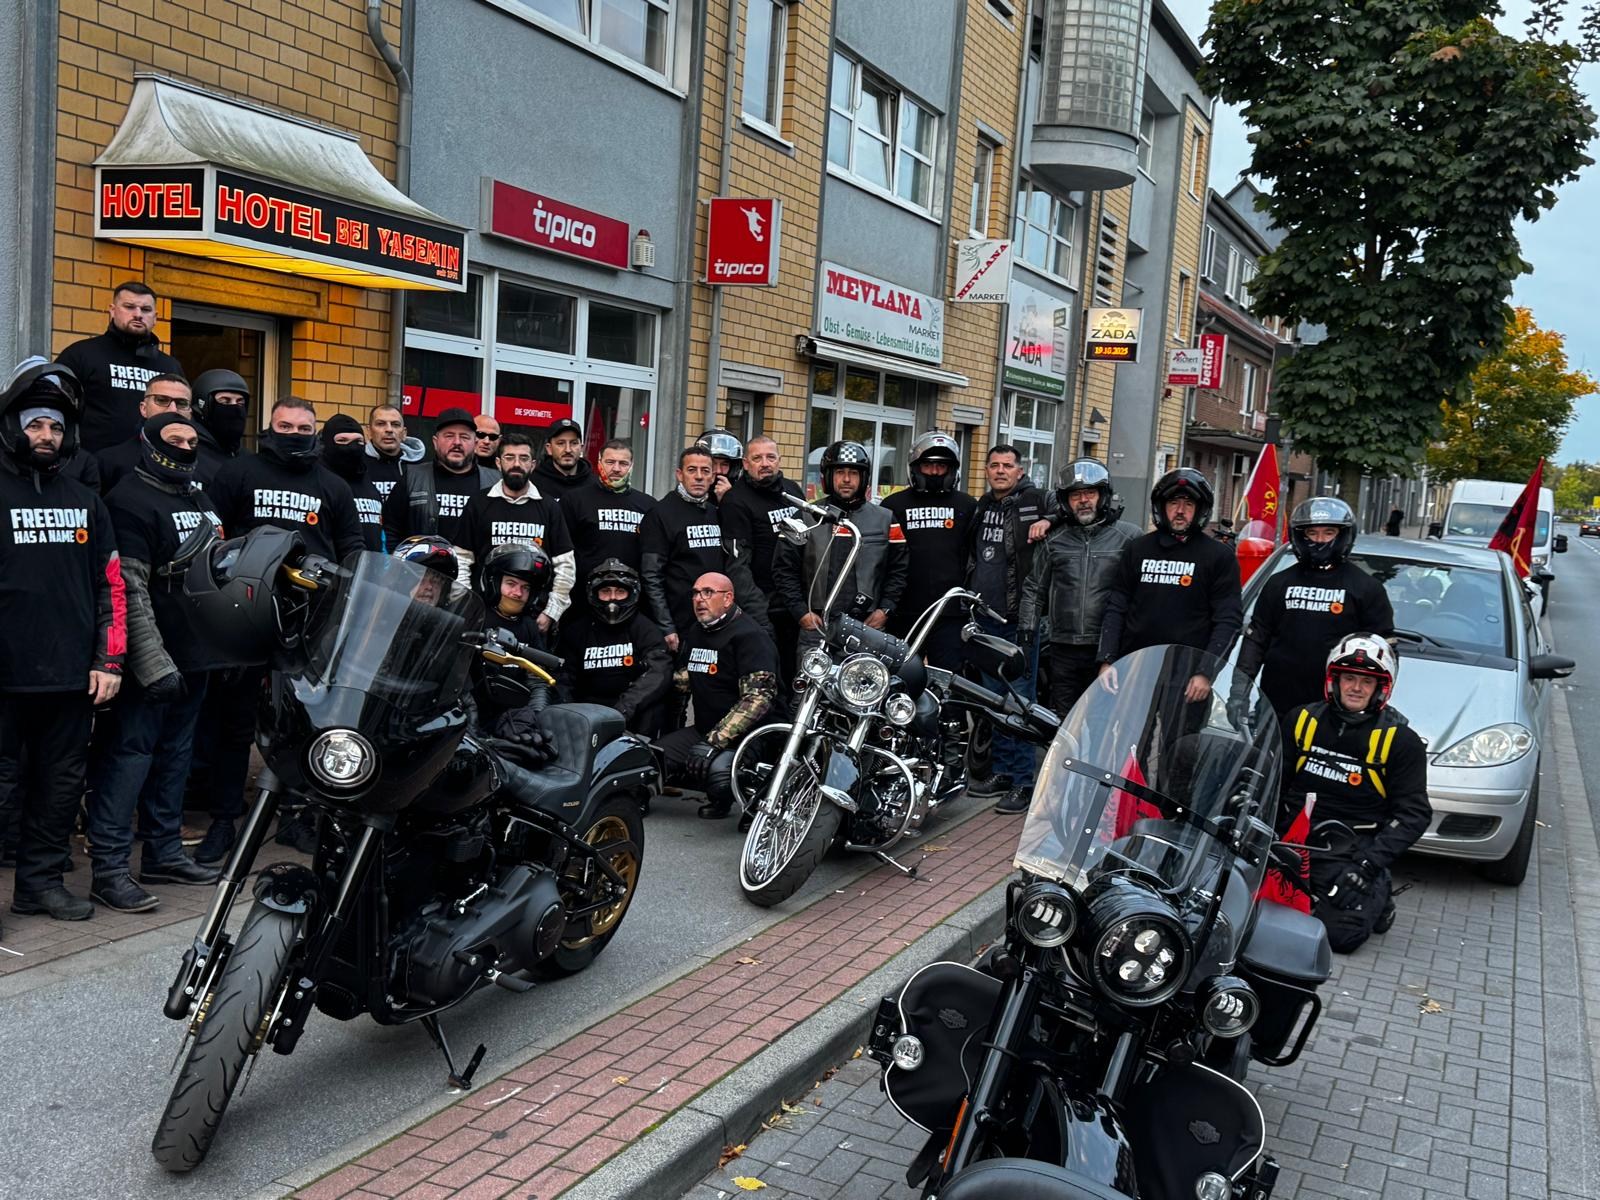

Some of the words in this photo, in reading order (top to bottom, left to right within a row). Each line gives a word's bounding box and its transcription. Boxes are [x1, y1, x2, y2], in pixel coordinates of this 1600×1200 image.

[102, 183, 201, 218] HOTEL
[217, 184, 332, 245] HOTEL
[335, 216, 369, 250] BEI
[377, 227, 460, 271] YASEMIN
[533, 199, 597, 248] tipico
[714, 258, 765, 278] tipico
[956, 244, 1009, 300] MEVLANA
[826, 269, 923, 321] MEVLANA
[969, 293, 1005, 301] MARKET
[823, 316, 840, 335] Obst
[846, 323, 871, 342] Gemüse
[876, 331, 914, 353] Lebensmittel
[915, 340, 920, 354] &
[921, 342, 940, 358] Fleisch
[908, 324, 940, 341] MARKET
[1091, 328, 1137, 340] ZADA
[1011, 335, 1043, 367] ZADA
[1200, 339, 1215, 386] bettica
[111, 378, 129, 389] HAS
[129, 380, 136, 390] A
[254, 488, 322, 514] FREEDOM
[10, 508, 88, 529] FREEDOM
[254, 506, 273, 518] HAS
[273, 507, 280, 518] A
[281, 508, 307, 523] NAME
[905, 507, 954, 521] FREEDOM
[491, 521, 545, 538] FREEDOM
[599, 521, 613, 531] HAS
[613, 522, 619, 531] A
[619, 522, 637, 534] NAME
[907, 521, 920, 530] HAS
[920, 520, 926, 529] A
[926, 519, 944, 529] NAME
[13, 530, 38, 544] HAS
[39, 530, 47, 543] A
[48, 529, 75, 543] NAME
[688, 539, 701, 548] HAS
[1141, 559, 1196, 576] FREEDOM
[1153, 574, 1159, 583] A
[1159, 574, 1181, 585] NAME
[1285, 586, 1346, 603] FREEDOM
[1299, 600, 1306, 610] A
[1306, 601, 1330, 611] NAME
[584, 642, 633, 660] FREEDOM
[689, 647, 718, 665] FREEDOM
[584, 660, 596, 670] HAS
[596, 659, 602, 668] A
[602, 657, 624, 668] NAME
